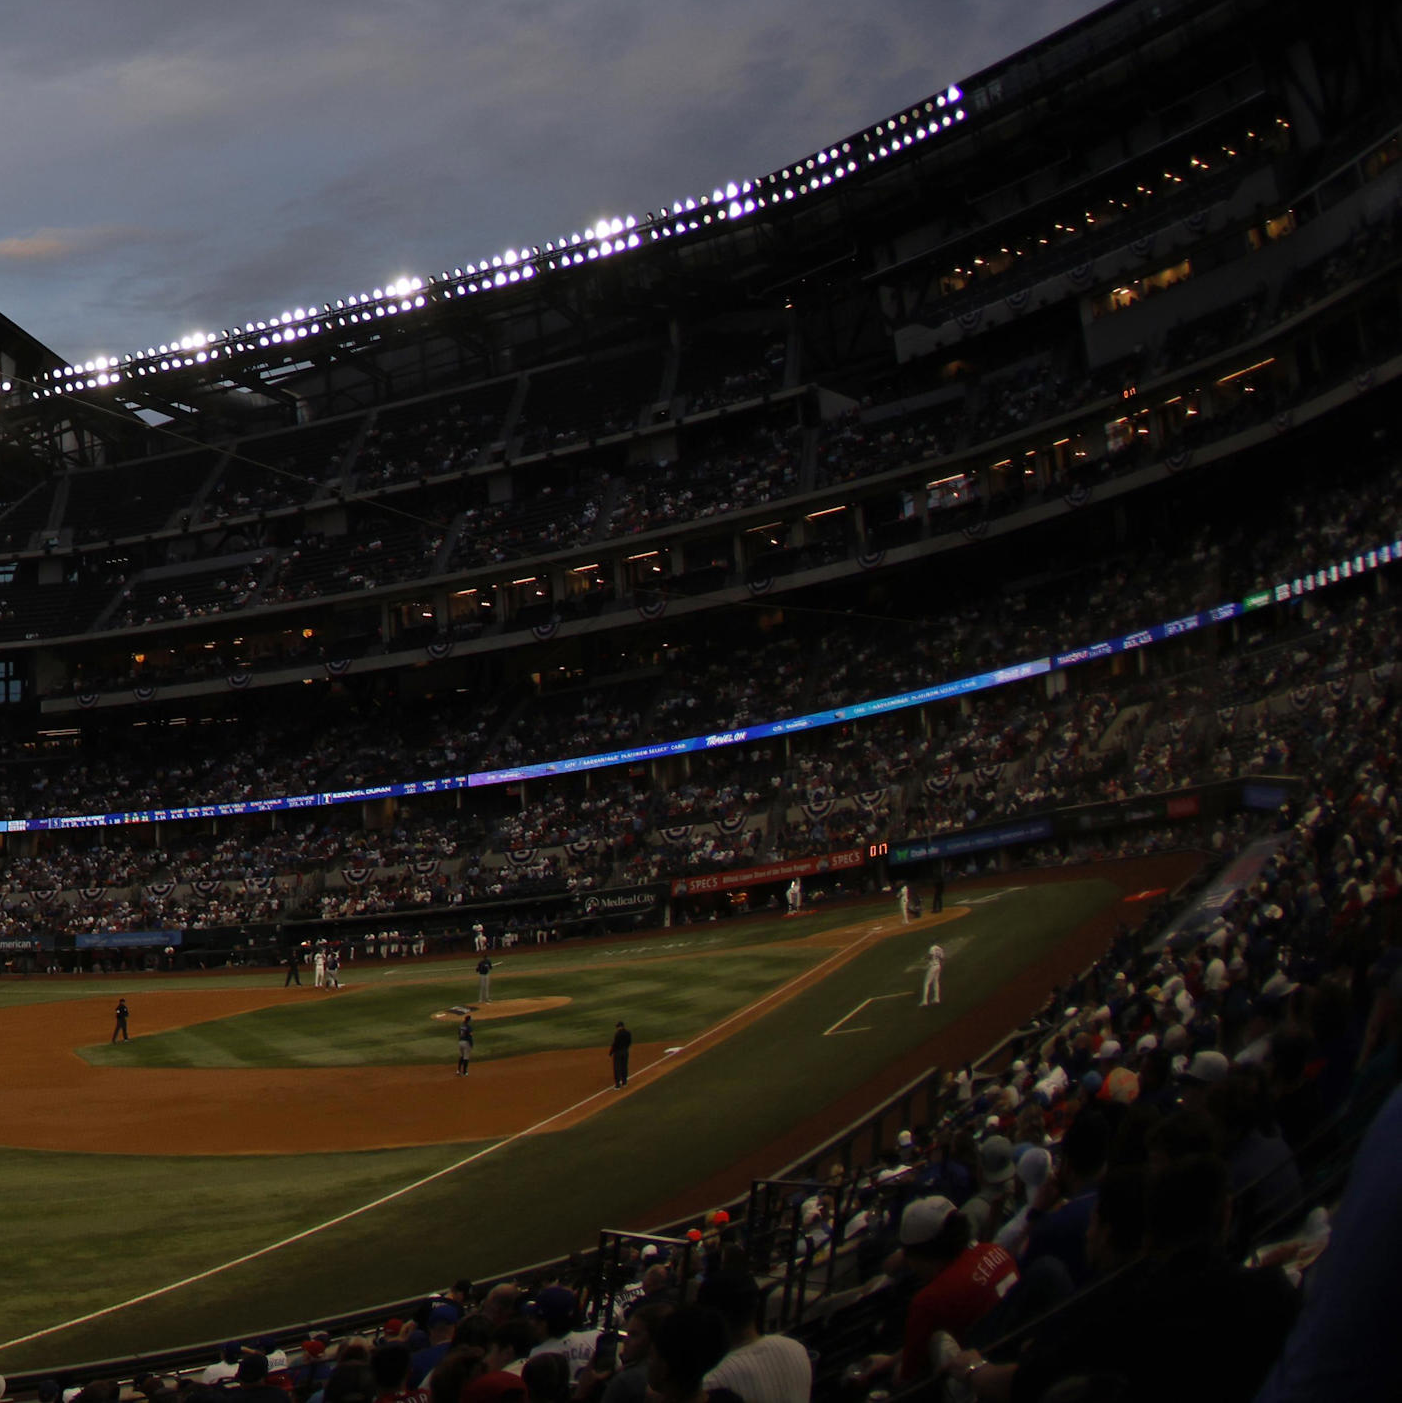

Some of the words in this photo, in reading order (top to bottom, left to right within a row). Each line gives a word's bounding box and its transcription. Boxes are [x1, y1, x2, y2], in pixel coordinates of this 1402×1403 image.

[831, 851, 862, 867] SPEC'S
[689, 876, 718, 891] SPEC'S
[636, 892, 658, 907] City
